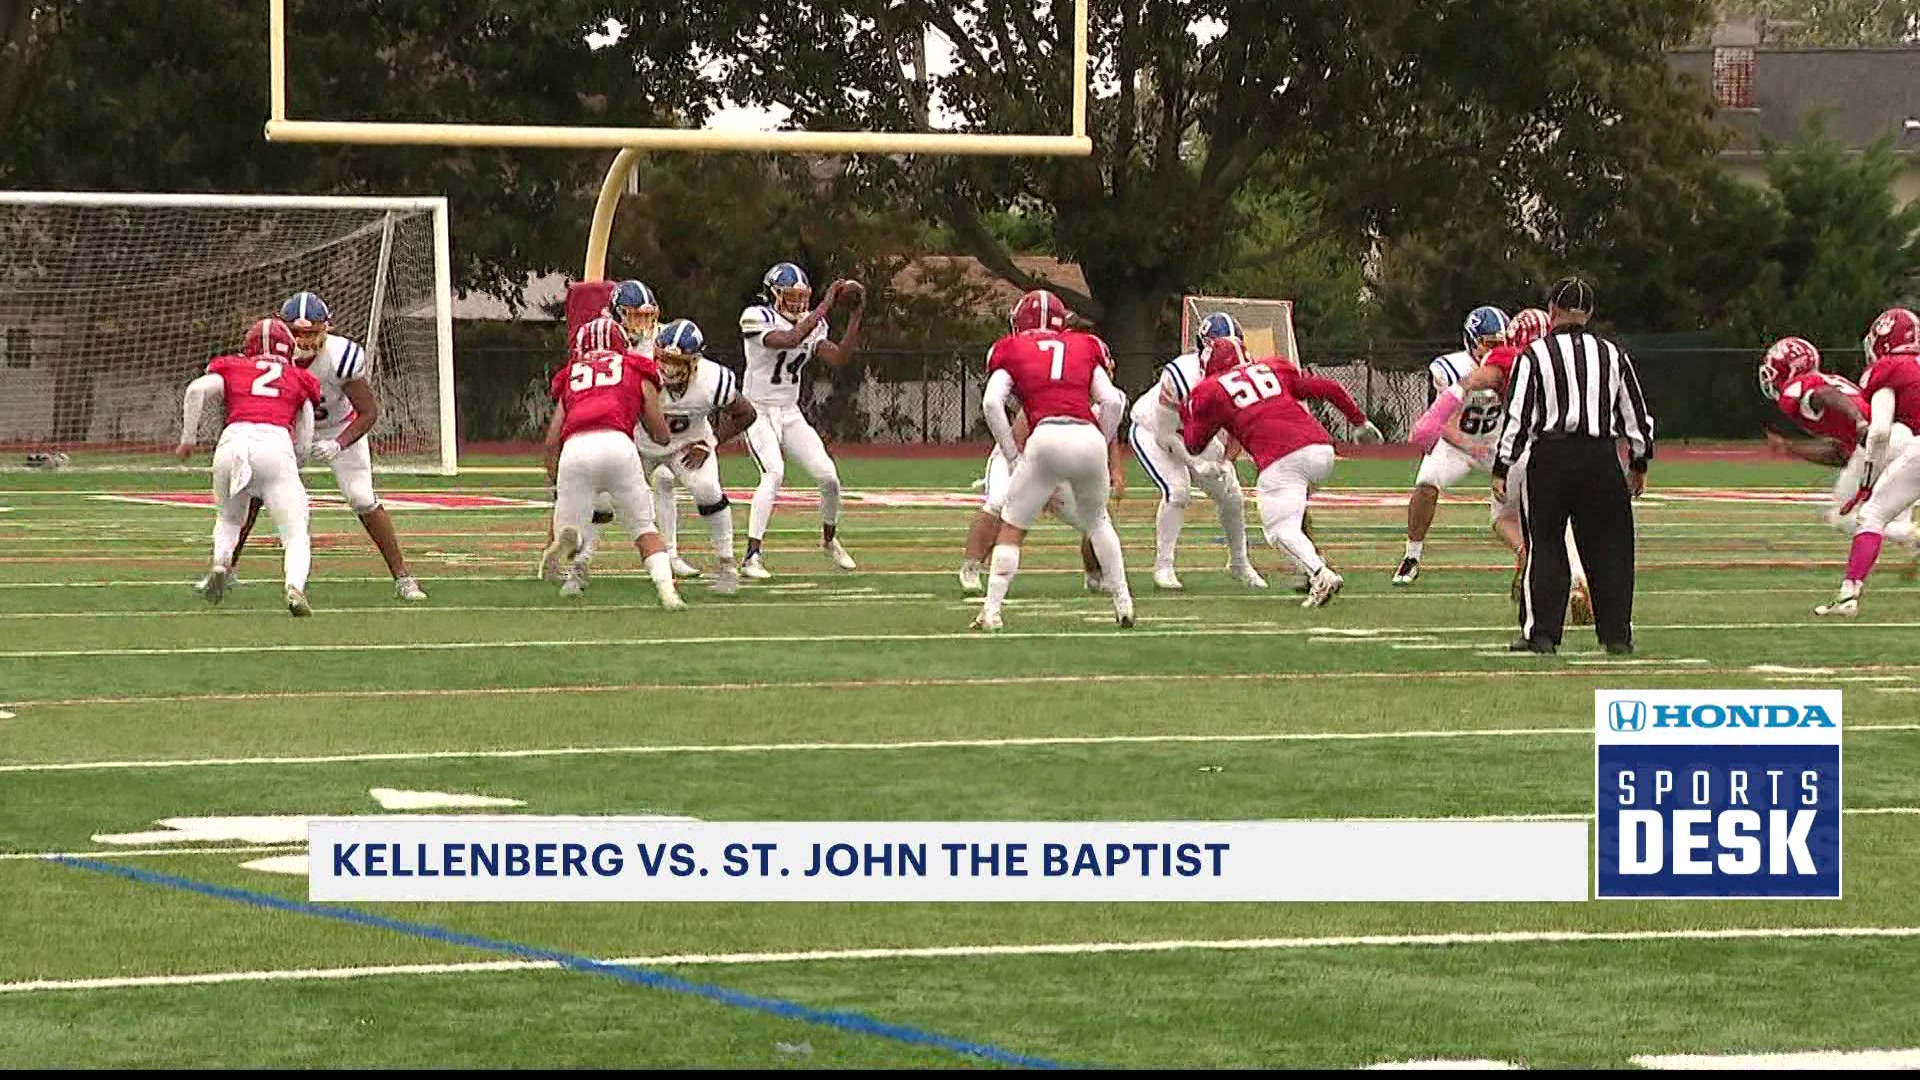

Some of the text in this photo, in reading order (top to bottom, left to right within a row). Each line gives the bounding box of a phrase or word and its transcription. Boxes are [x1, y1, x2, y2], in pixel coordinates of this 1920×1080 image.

[251, 360, 283, 397] 2
[569, 354, 623, 391] 53
[770, 351, 806, 384] 14
[1036, 339, 1066, 381] 7
[1216, 363, 1282, 408] 56
